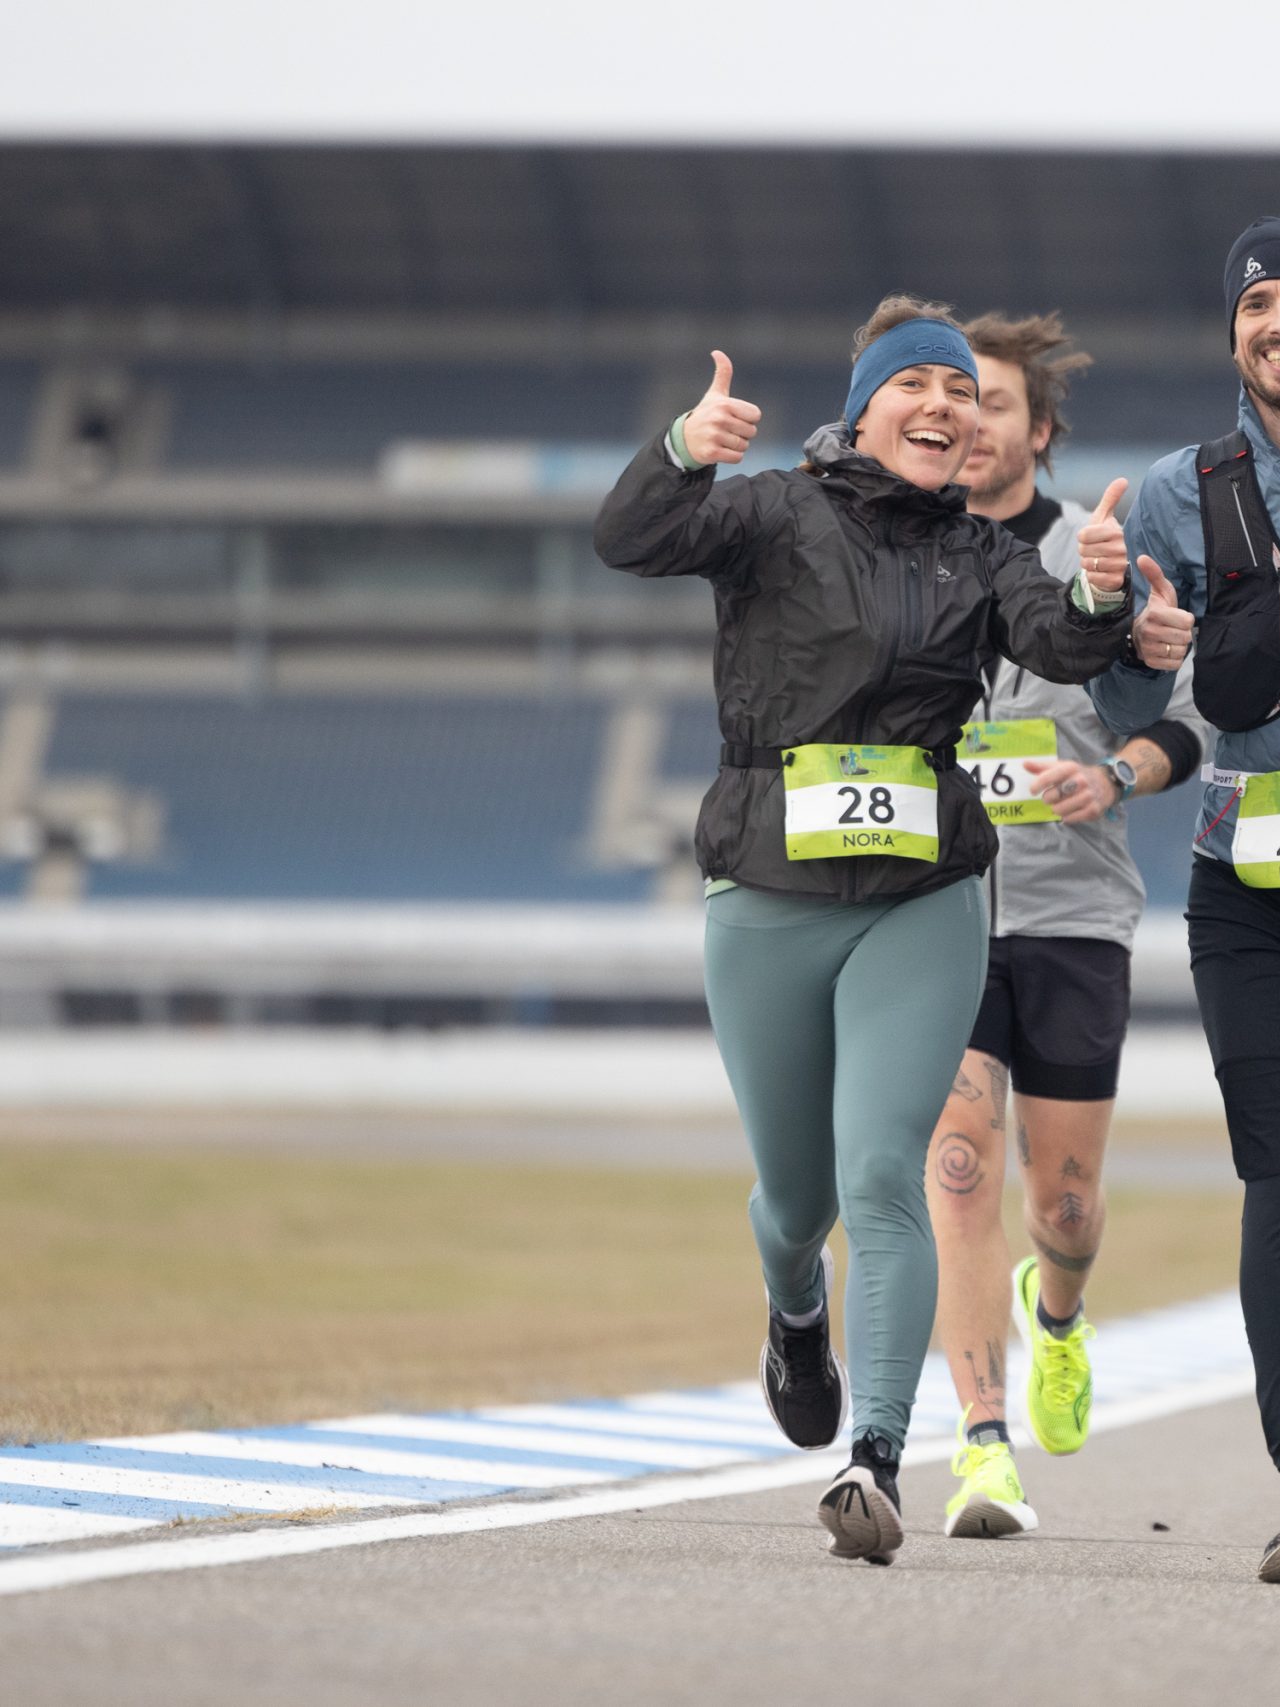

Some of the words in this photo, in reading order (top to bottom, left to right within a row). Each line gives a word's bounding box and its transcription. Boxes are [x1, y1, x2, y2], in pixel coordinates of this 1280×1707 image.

[837, 786, 896, 824] 28
[985, 804, 1025, 818] DRIK
[842, 832, 895, 848] NORA
